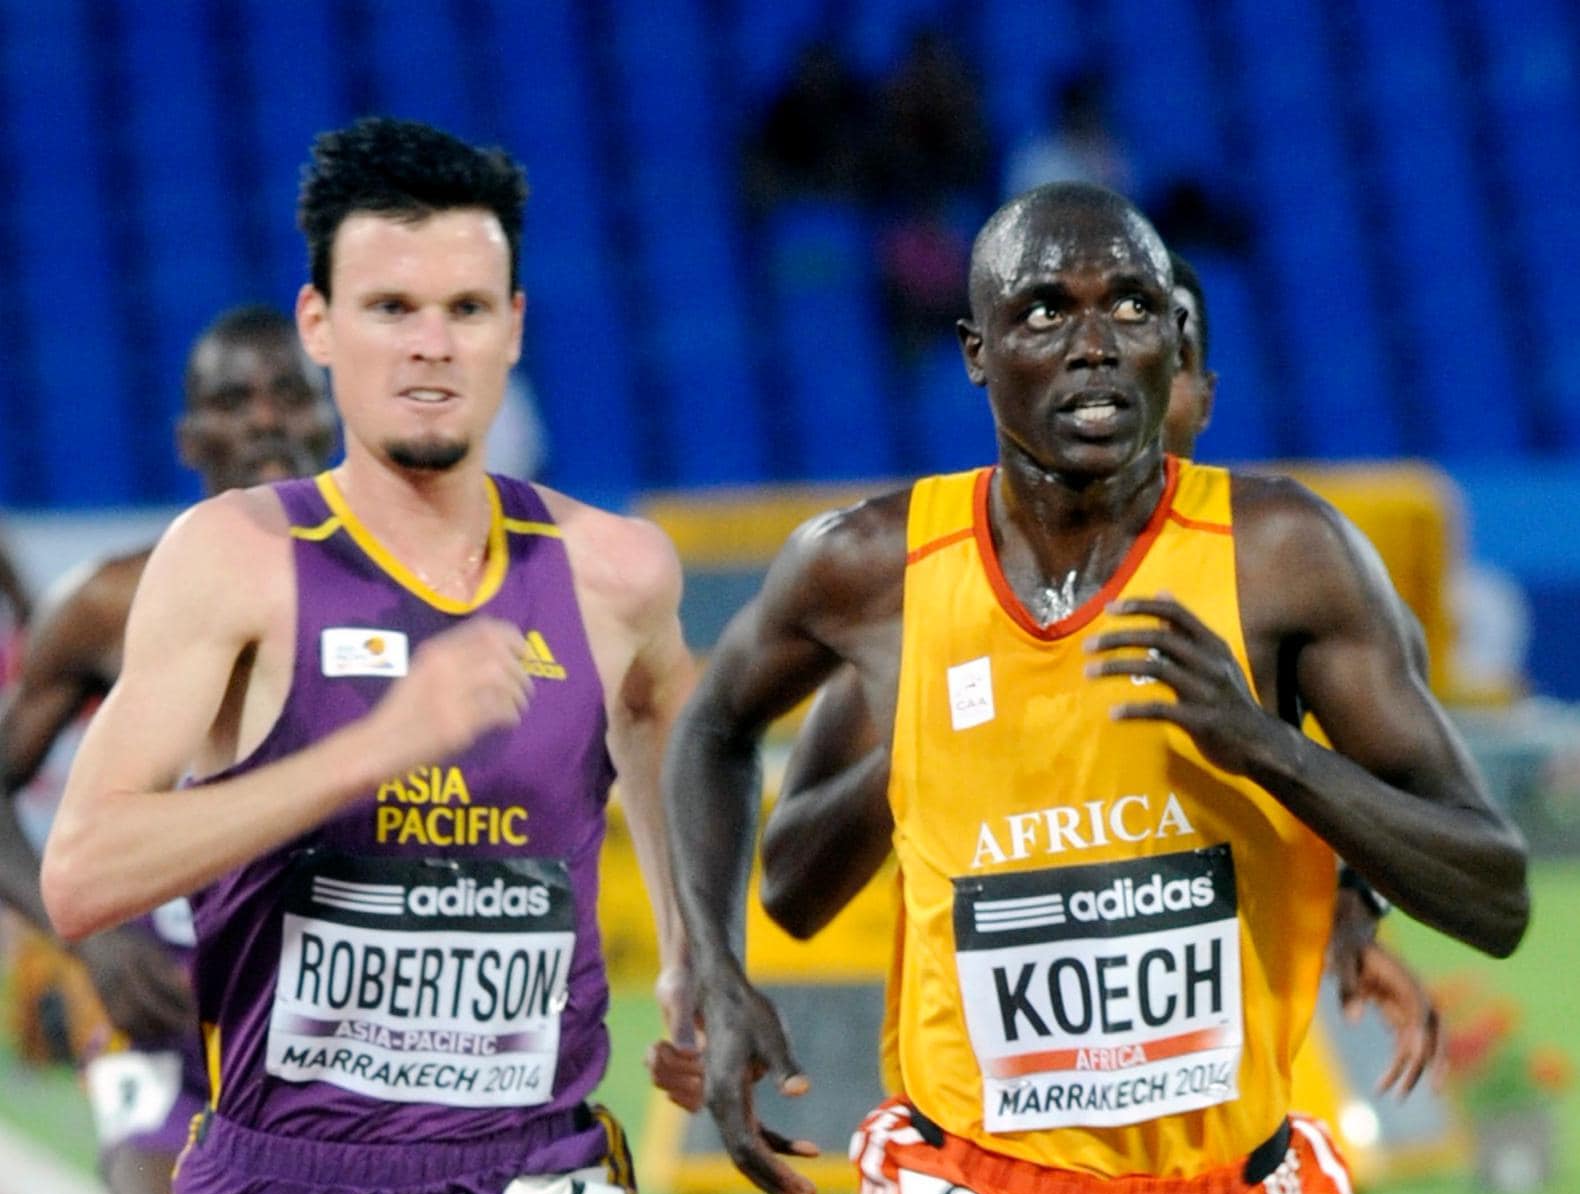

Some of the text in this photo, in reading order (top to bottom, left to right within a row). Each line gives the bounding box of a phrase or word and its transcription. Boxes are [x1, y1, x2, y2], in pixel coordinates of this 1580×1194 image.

[377, 766, 471, 804] ASIA
[377, 805, 528, 846] PACIFIC
[971, 792, 1195, 868] AFRICA
[408, 878, 550, 917] adidas
[1069, 874, 1214, 922] adidas
[295, 931, 561, 1022] ROBERTSON
[992, 938, 1222, 1041] KOECH
[334, 1020, 497, 1055] ASIA-PACIFIC
[1076, 1045, 1147, 1072] AFRICA
[281, 1046, 541, 1093] MARRAKECH 2014
[998, 1073, 1167, 1116] MARRAKECH
